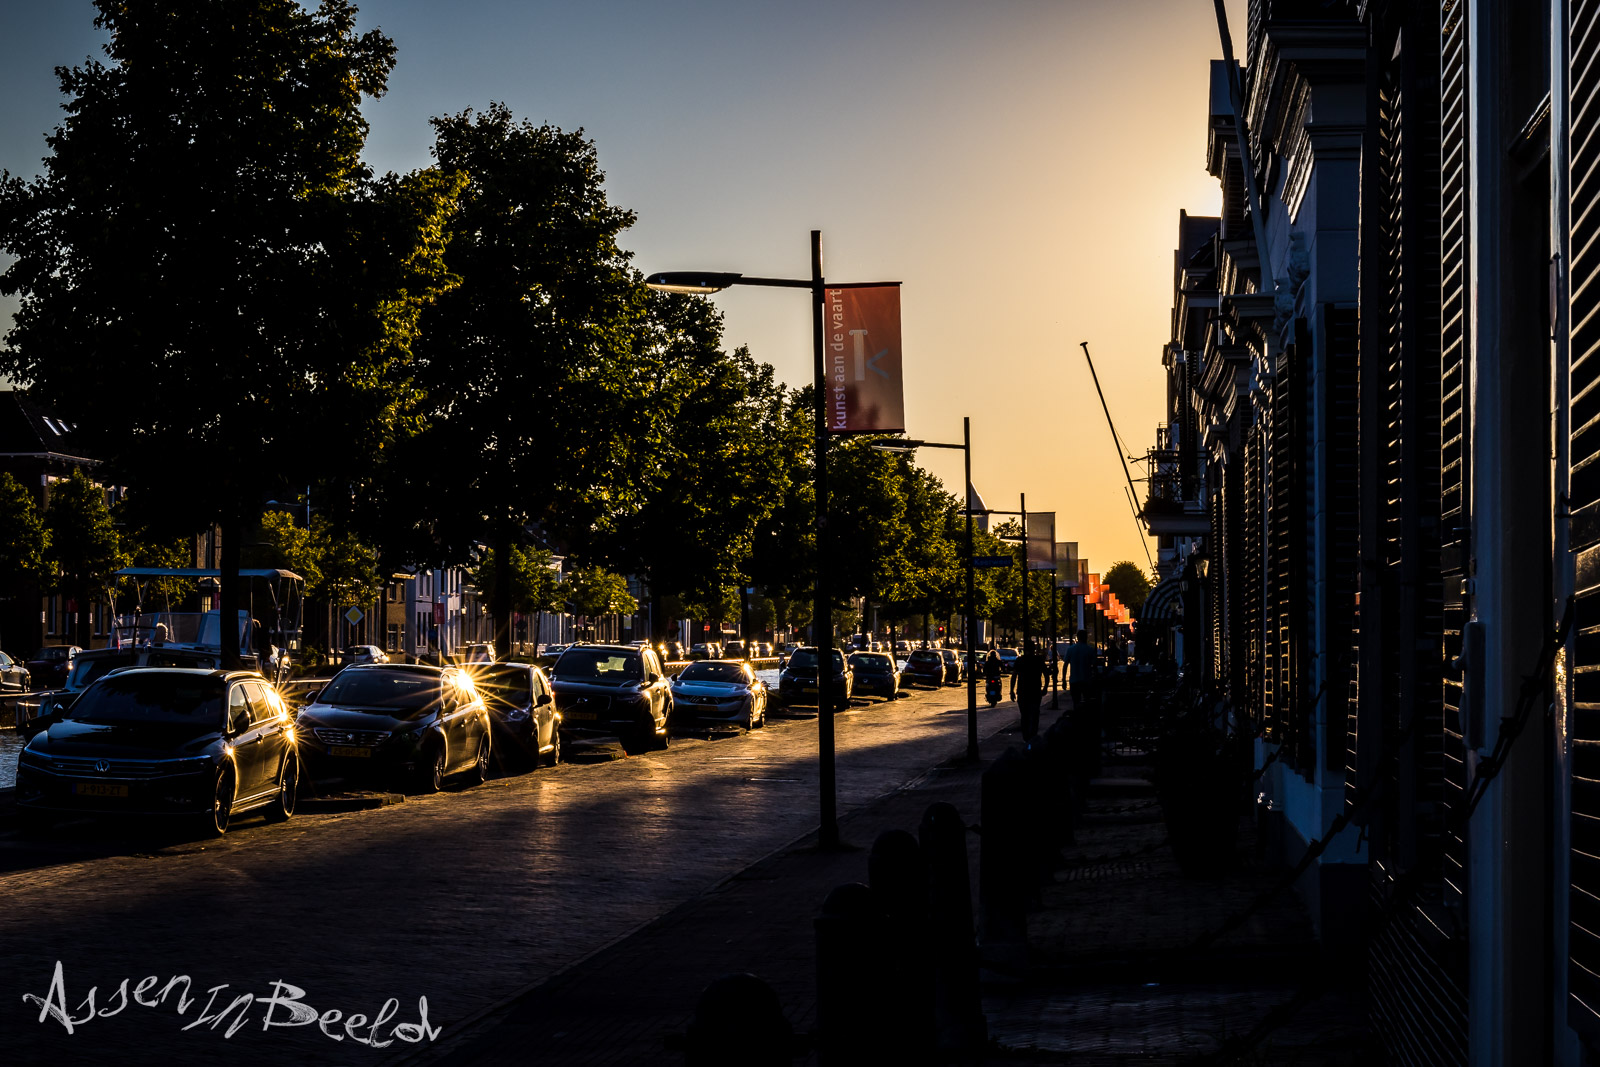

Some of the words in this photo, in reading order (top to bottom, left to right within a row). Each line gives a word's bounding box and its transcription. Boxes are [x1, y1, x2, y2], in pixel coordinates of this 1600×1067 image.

[830, 289, 843, 330] vaart
[830, 333, 844, 352] de
[834, 355, 845, 382] aan
[833, 385, 847, 430] kunst
[80, 784, 121, 796] J-913-ZT
